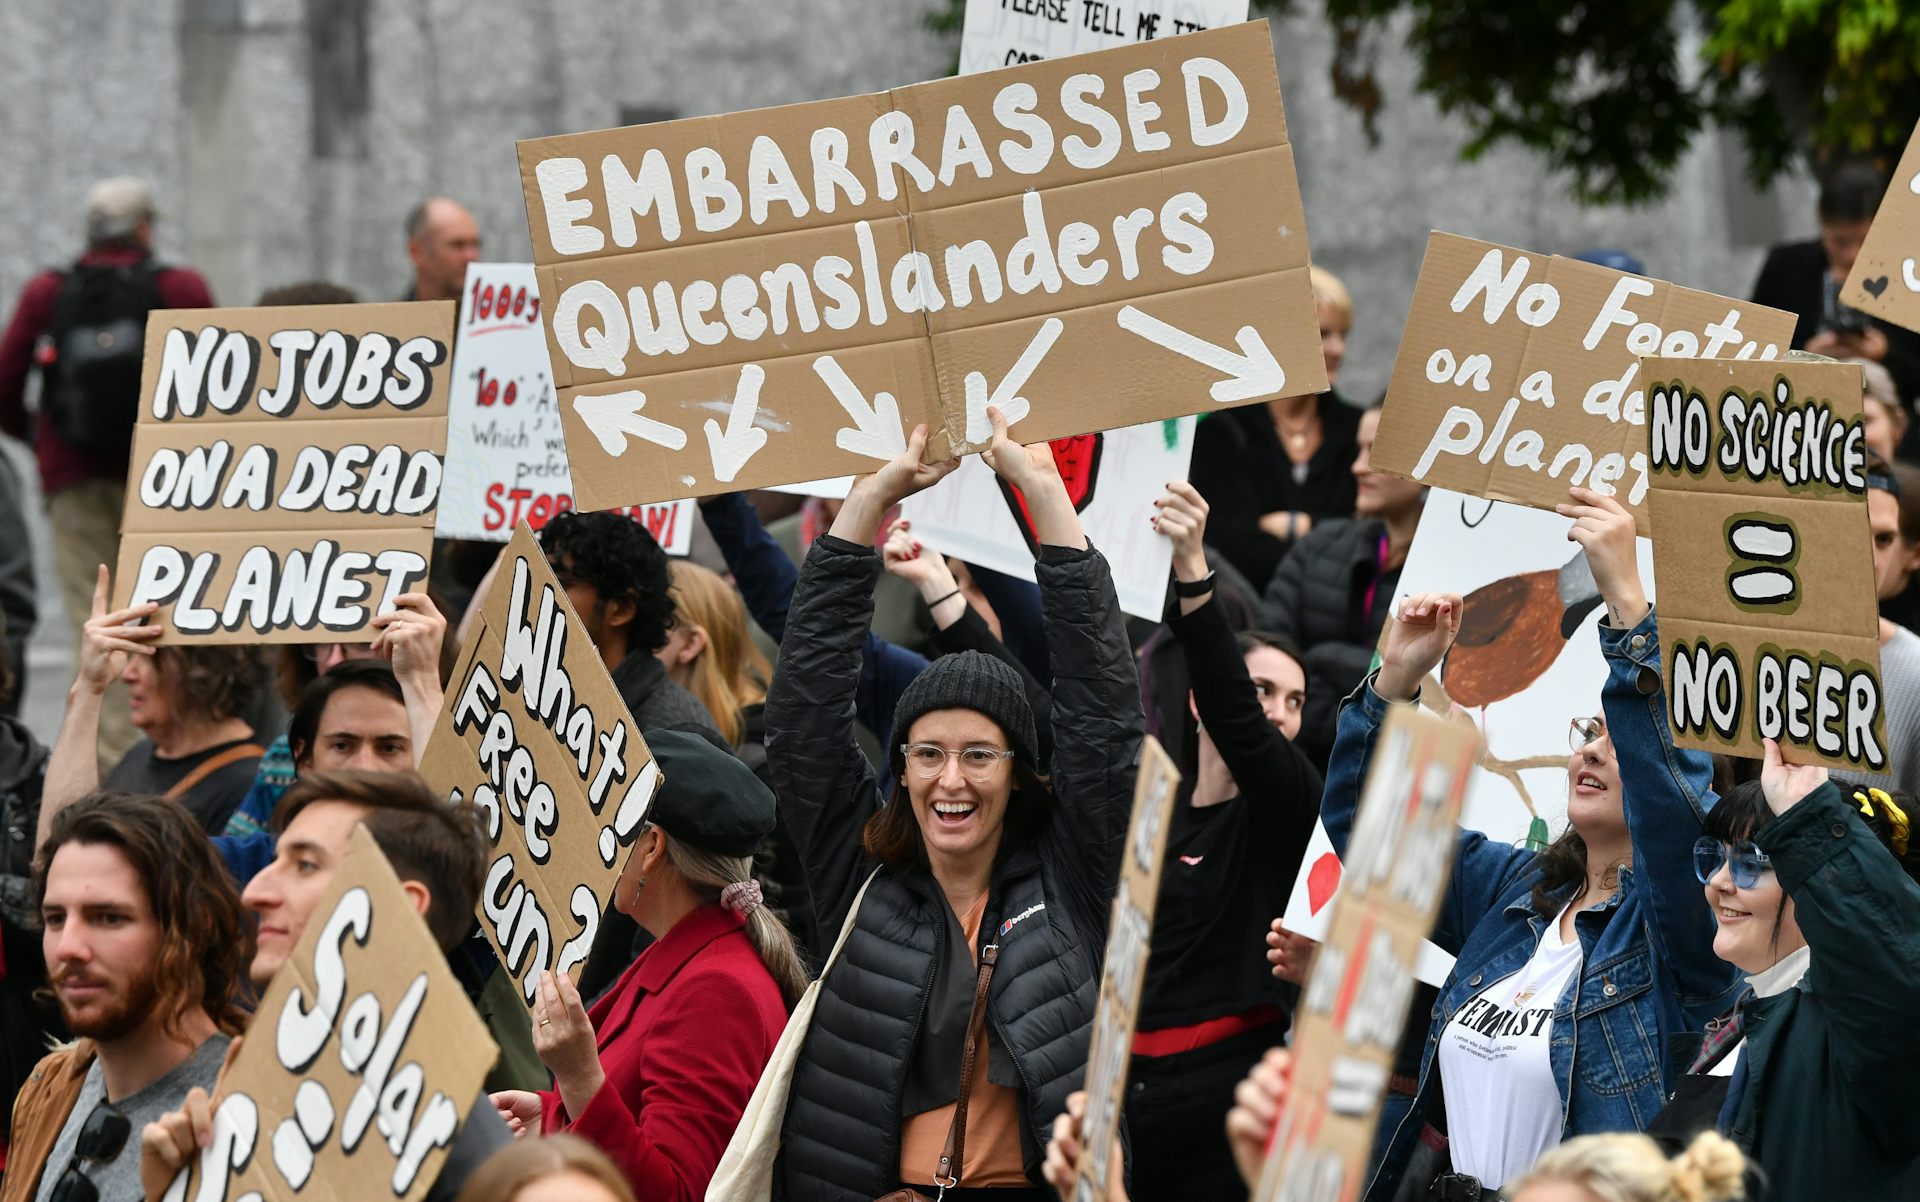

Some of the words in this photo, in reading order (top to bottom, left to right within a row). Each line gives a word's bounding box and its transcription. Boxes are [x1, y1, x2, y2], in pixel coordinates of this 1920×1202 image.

[1083, 1, 1125, 37] TELL
[1137, 12, 1162, 41] ME
[535, 57, 1249, 255] EMBARRASSED
[553, 192, 1215, 376] Queenslanders
[1450, 249, 1560, 326] No
[152, 325, 261, 421] NO
[257, 329, 447, 417] JOBS
[1426, 349, 1492, 392] on
[1520, 370, 1555, 408] a
[1583, 363, 1645, 425] de
[140, 440, 234, 511] ON
[222, 444, 277, 511] A
[278, 444, 444, 515] DEAD
[471, 421, 530, 448] Which
[1411, 397, 1649, 506] planet
[1648, 385, 1711, 474] NO
[122, 539, 428, 635] PLANET
[500, 556, 659, 869] What!
[1671, 642, 1741, 742] NO
[1757, 651, 1887, 770] BEER
[276, 886, 459, 1196] Solar
